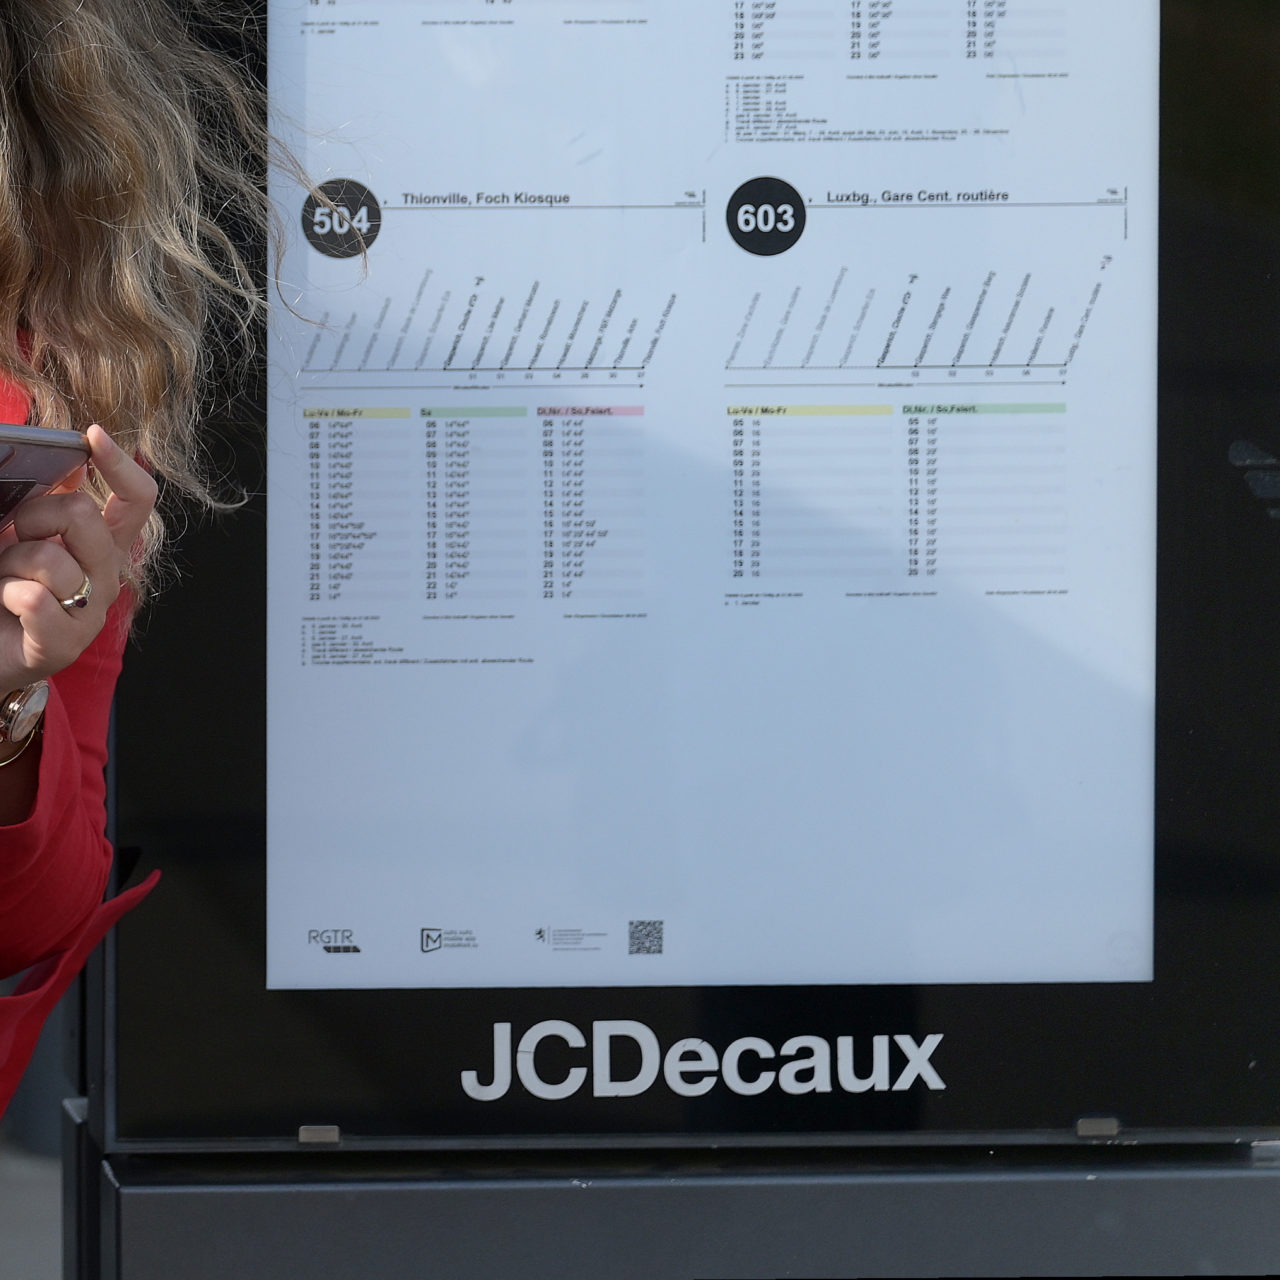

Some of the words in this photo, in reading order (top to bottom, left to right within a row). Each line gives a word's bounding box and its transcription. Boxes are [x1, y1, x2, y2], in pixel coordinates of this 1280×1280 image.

[312, 204, 372, 236] 504
[402, 192, 472, 206] Thionville,
[475, 192, 510, 204] Foch
[513, 192, 571, 207] Kiosque
[737, 203, 796, 233] 603
[826, 191, 877, 205] Luxbg.,
[881, 191, 914, 203] Gare
[917, 190, 953, 202] Cent.
[956, 190, 1010, 202] routière
[307, 929, 354, 944] RGTR
[460, 1018, 948, 1103] JCDecaux
